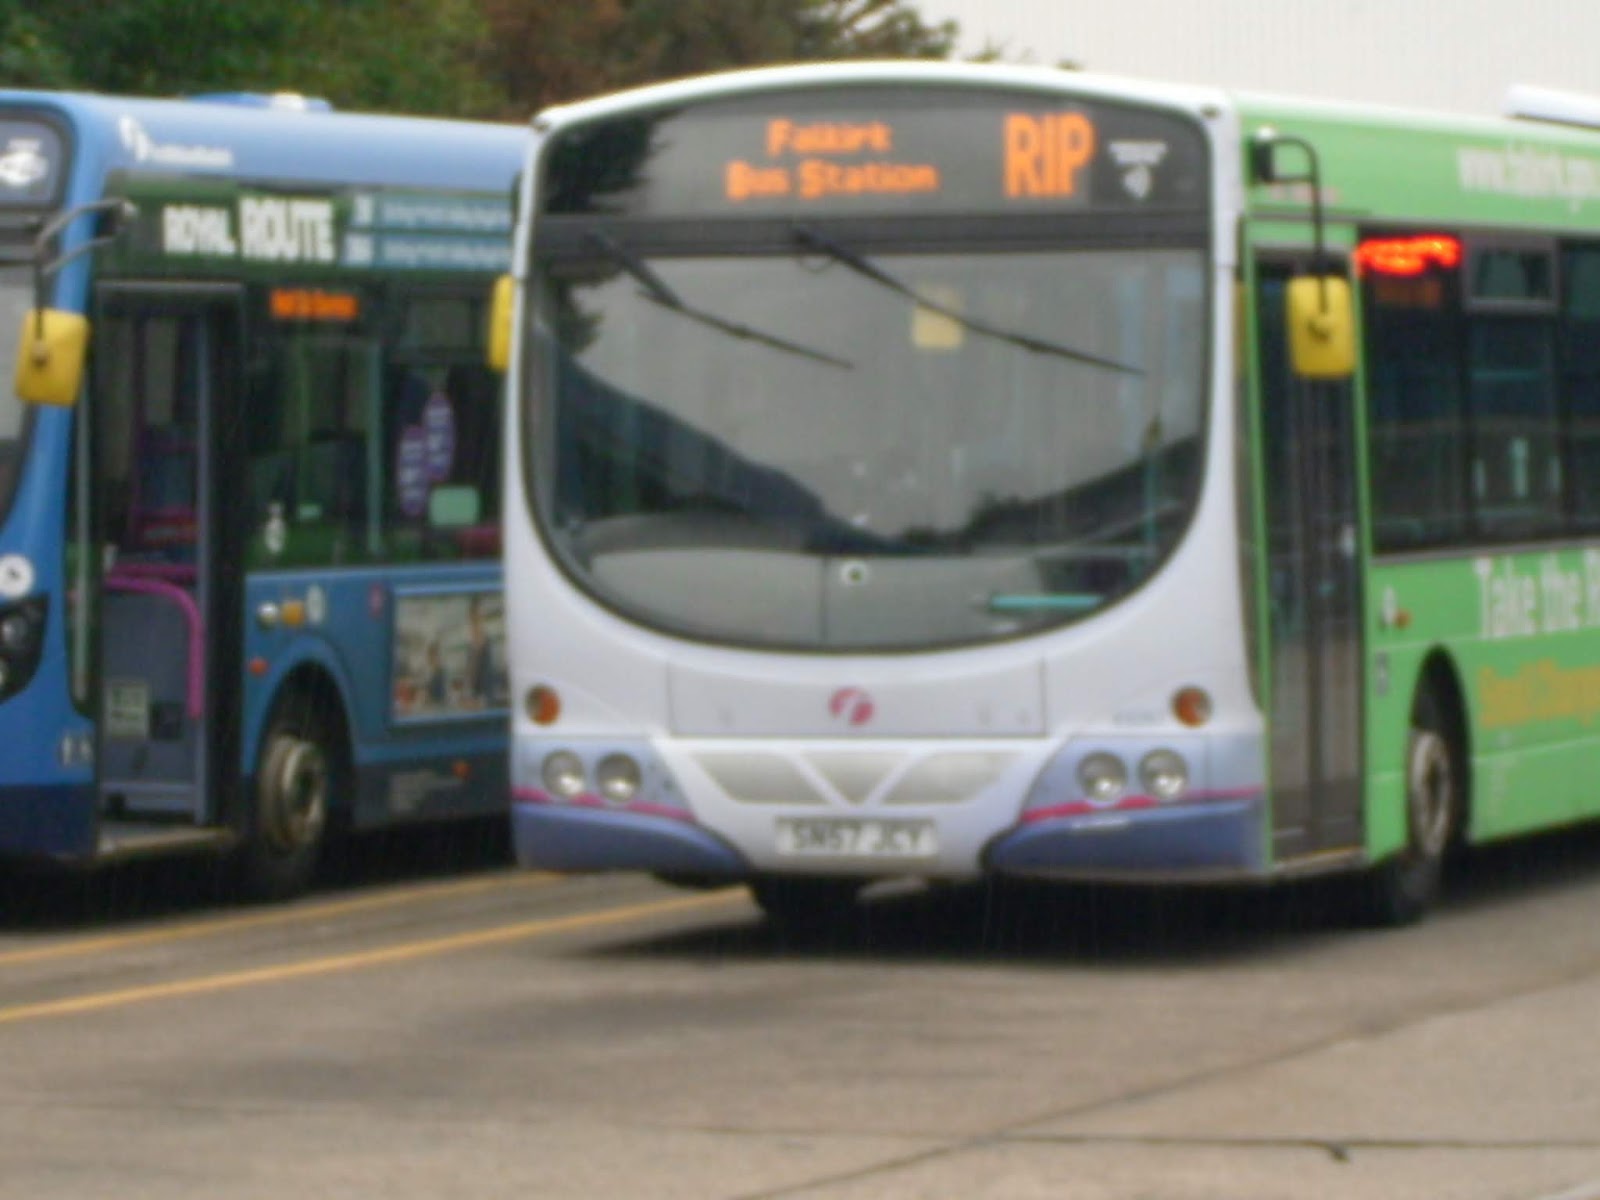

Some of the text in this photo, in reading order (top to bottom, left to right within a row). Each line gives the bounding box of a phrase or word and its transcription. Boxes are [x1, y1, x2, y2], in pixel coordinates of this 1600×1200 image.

[726, 160, 938, 200] Bus Station
[1004, 113, 1094, 197] RIP
[163, 204, 235, 253] ROYAL
[239, 197, 334, 261] ROUTE
[1473, 556, 1535, 639] Take
[1540, 550, 1581, 634] the
